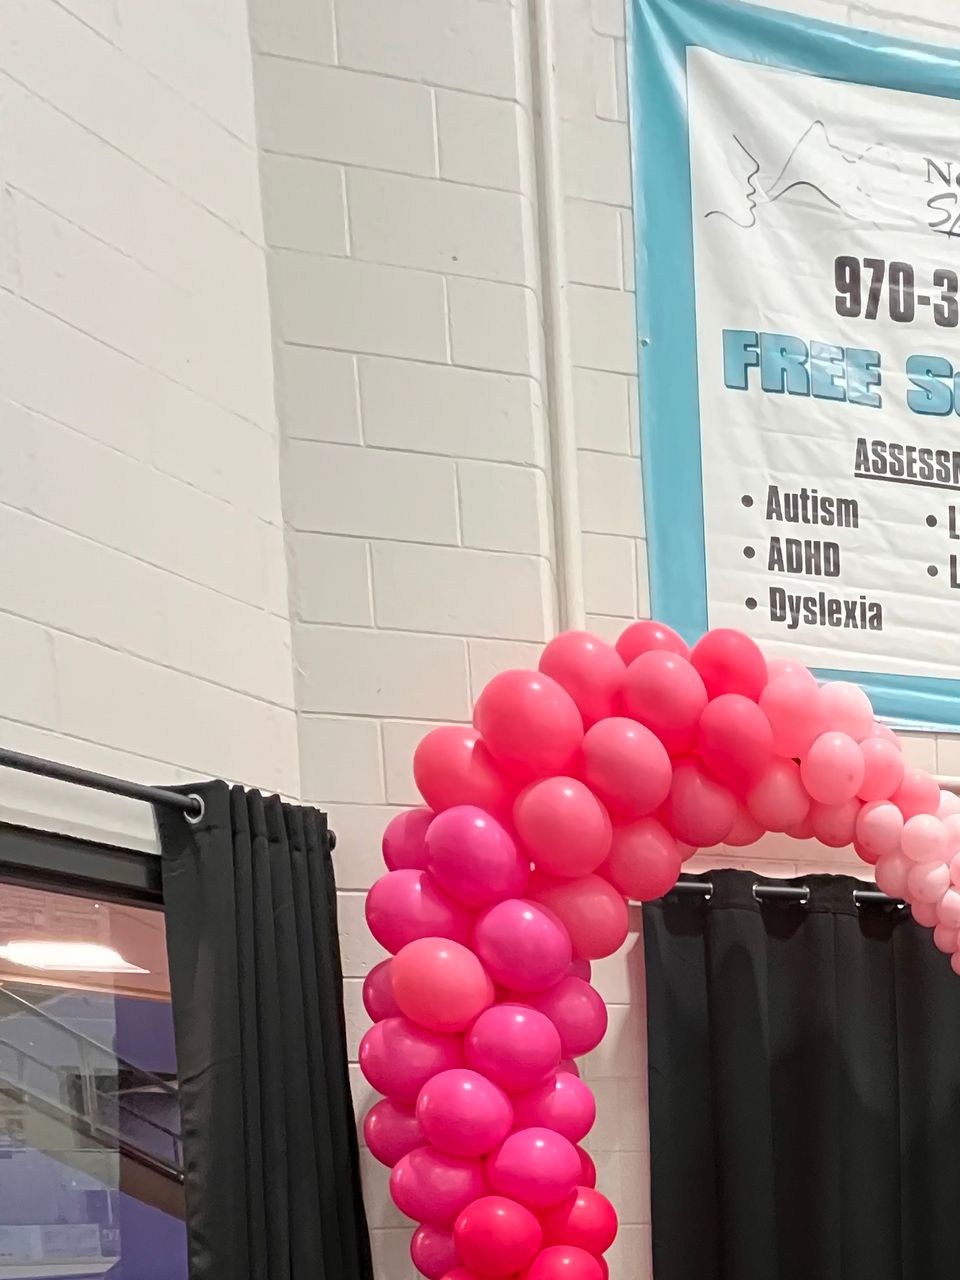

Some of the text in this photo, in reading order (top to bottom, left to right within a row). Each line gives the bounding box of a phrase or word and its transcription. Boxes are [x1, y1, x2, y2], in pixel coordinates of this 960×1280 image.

[722, 329, 882, 408] FREE
[766, 485, 859, 529] Autism
[768, 536, 840, 578] ADHD
[770, 587, 883, 631] Dyslexia
